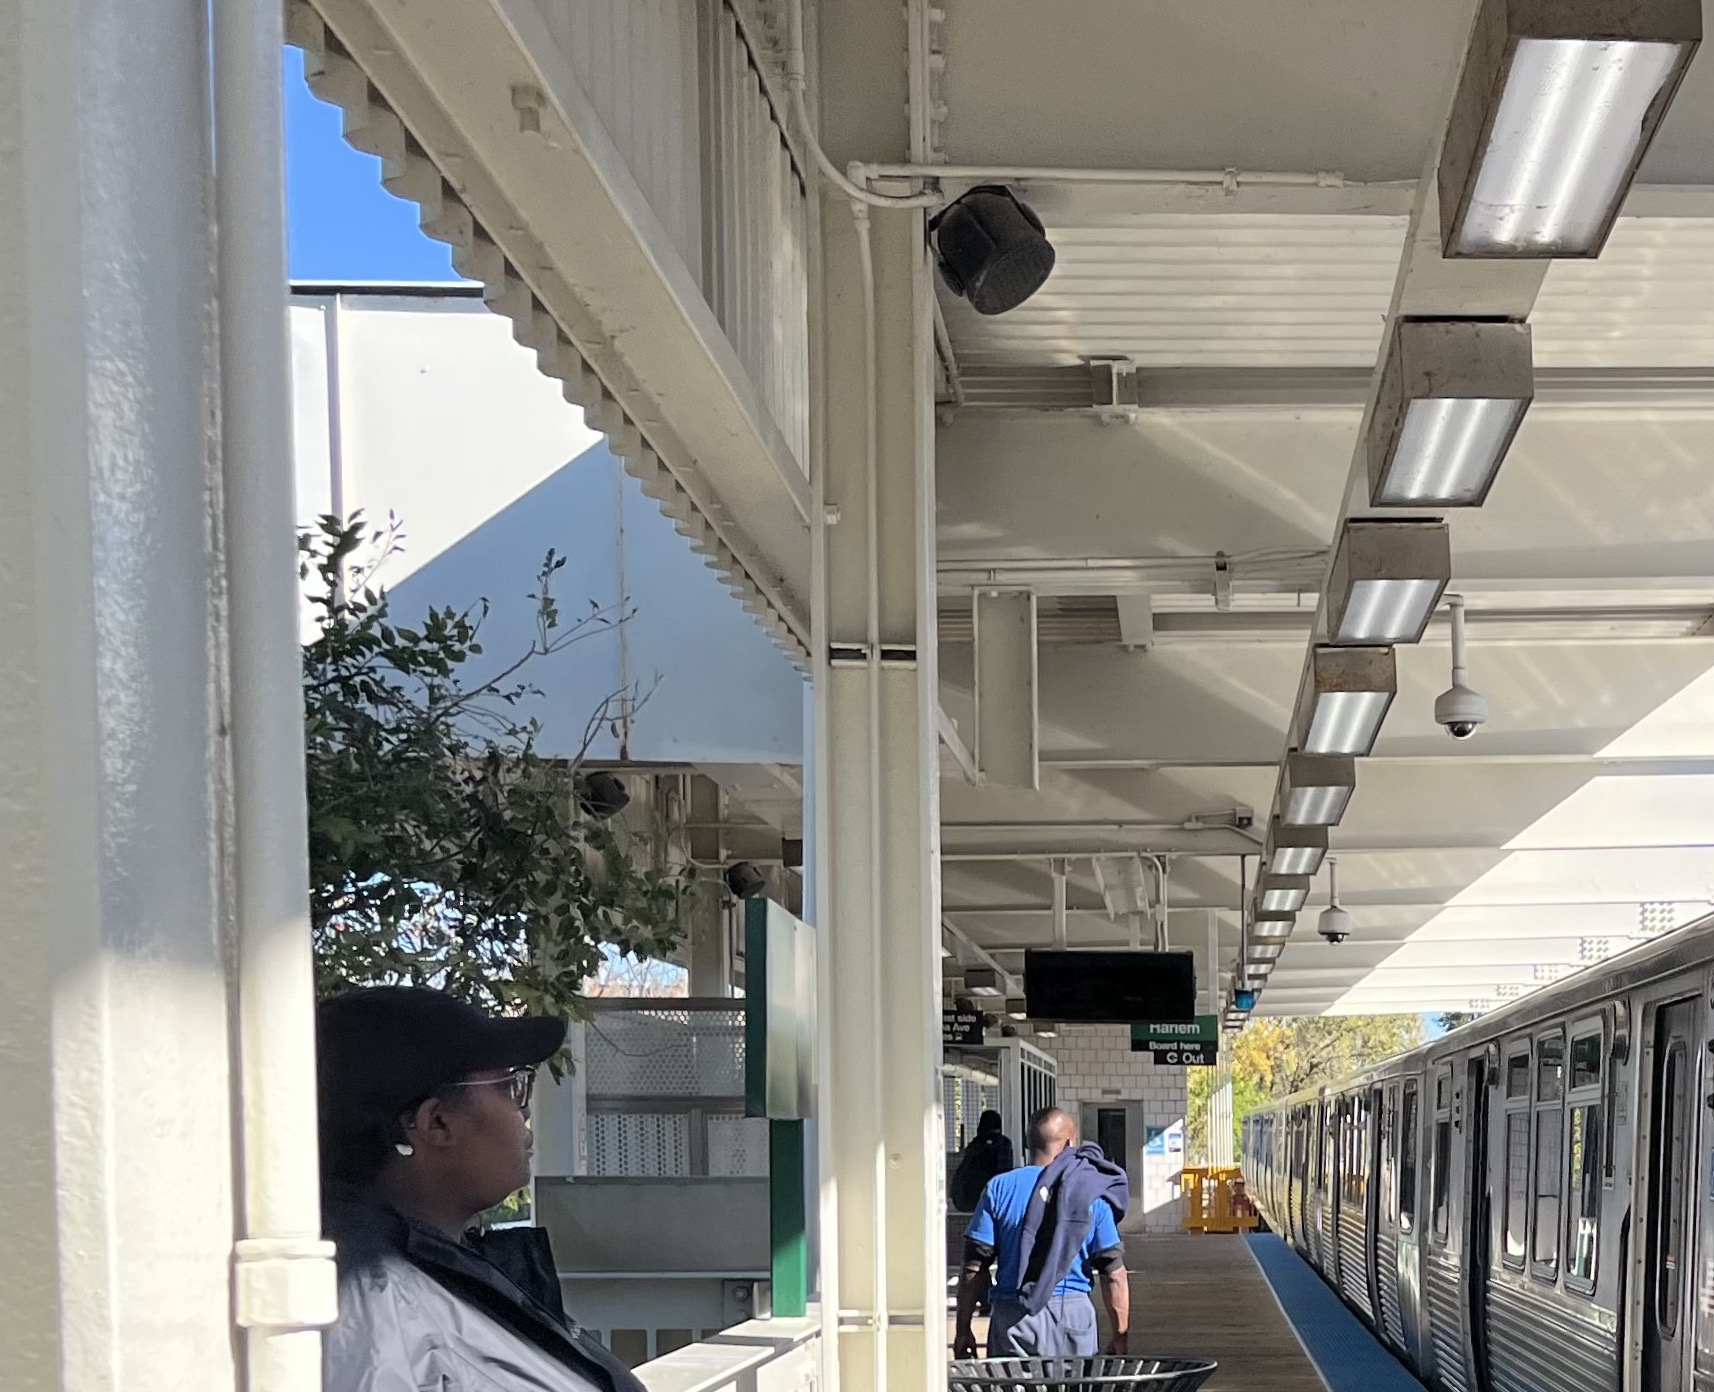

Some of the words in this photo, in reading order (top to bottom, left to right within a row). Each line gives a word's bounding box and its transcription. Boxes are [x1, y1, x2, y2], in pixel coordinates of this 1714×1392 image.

[1149, 1023, 1200, 1034] Harlem
[1148, 1041, 1178, 1050] Board
[1180, 1042, 1201, 1051] here
[1182, 1052, 1205, 1064] Out
